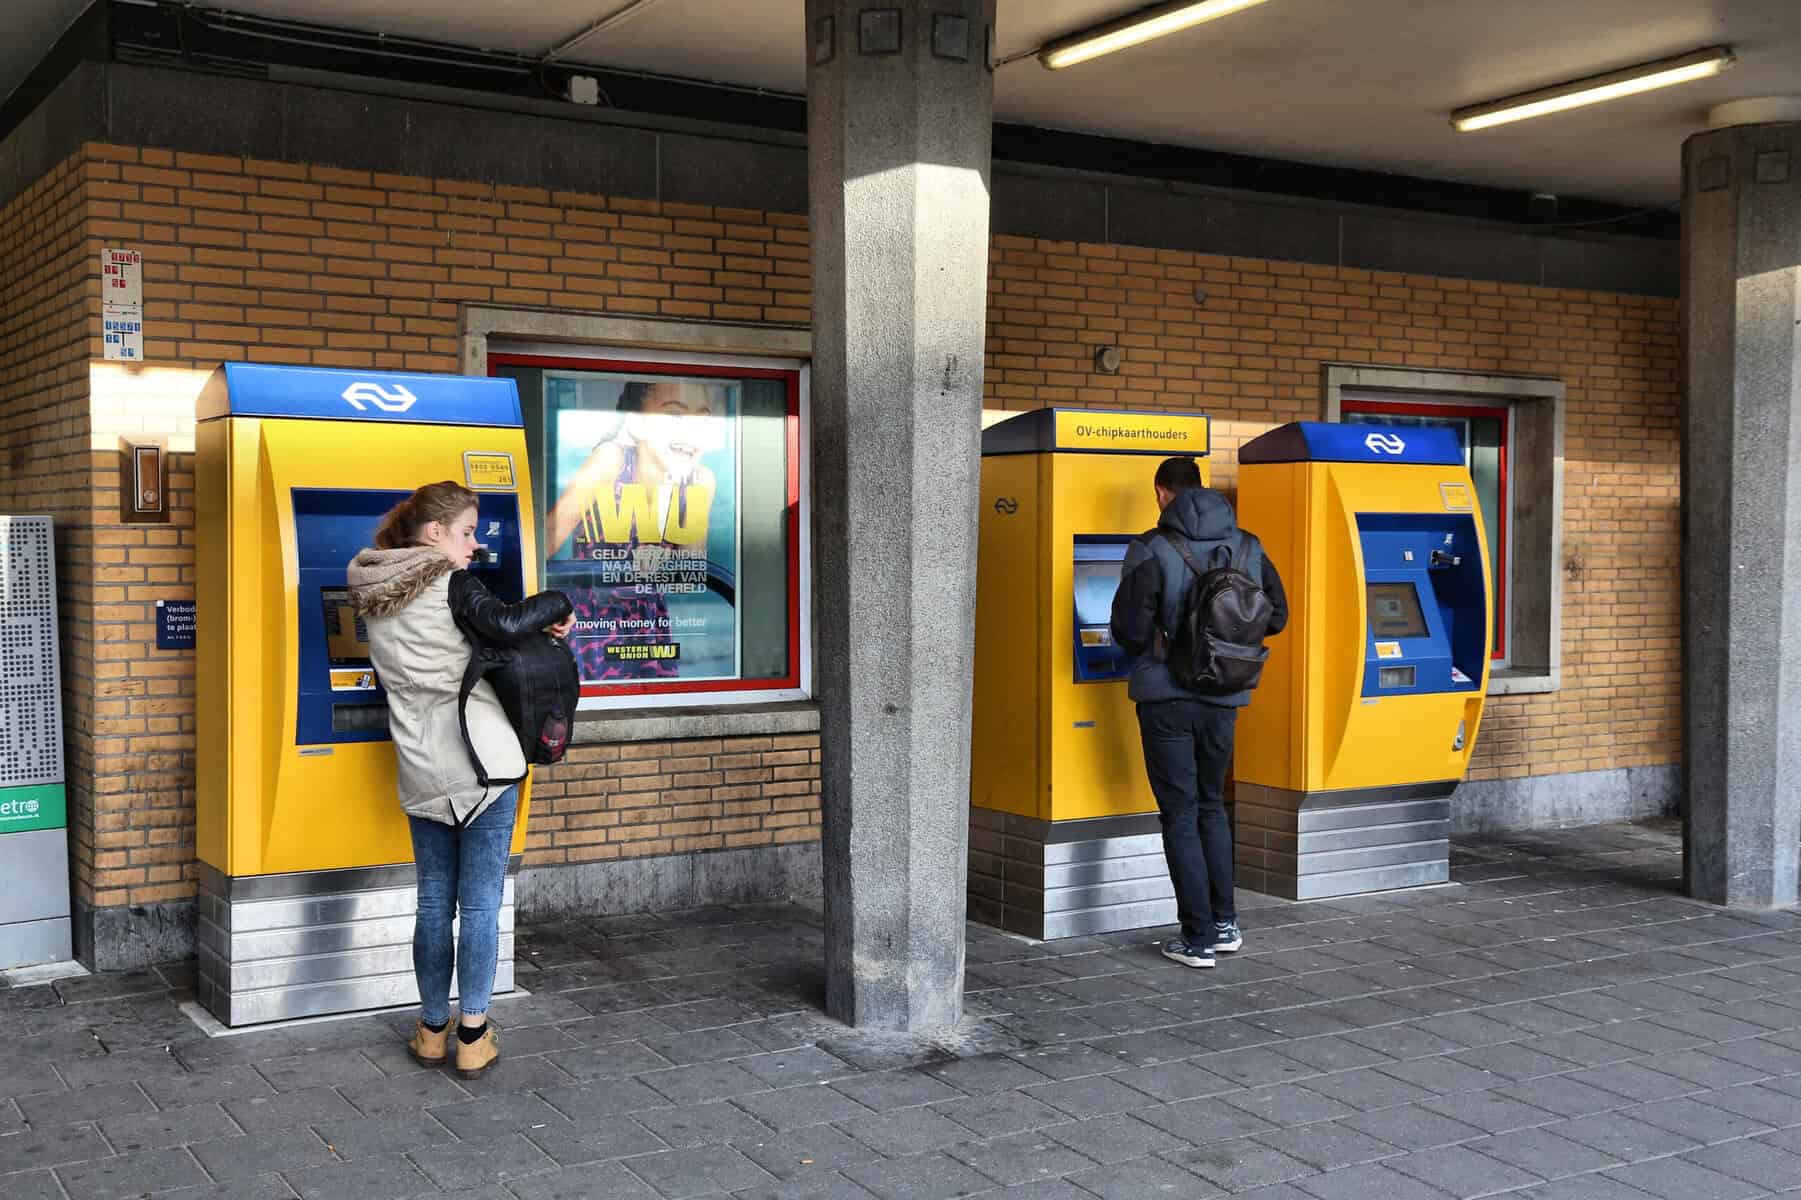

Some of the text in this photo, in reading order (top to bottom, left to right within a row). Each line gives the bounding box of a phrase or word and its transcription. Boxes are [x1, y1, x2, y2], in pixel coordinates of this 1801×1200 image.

[1076, 425, 1188, 440] OV-chipkaarthouders
[578, 483, 708, 545] WU
[592, 549, 628, 560] GELD
[602, 560, 707, 571] NAAR MAGHREB
[602, 571, 707, 583] EN DE REST VAN
[635, 583, 707, 594] DE WERELD
[575, 616, 706, 631] moving money for better
[607, 646, 648, 654] WESTERN
